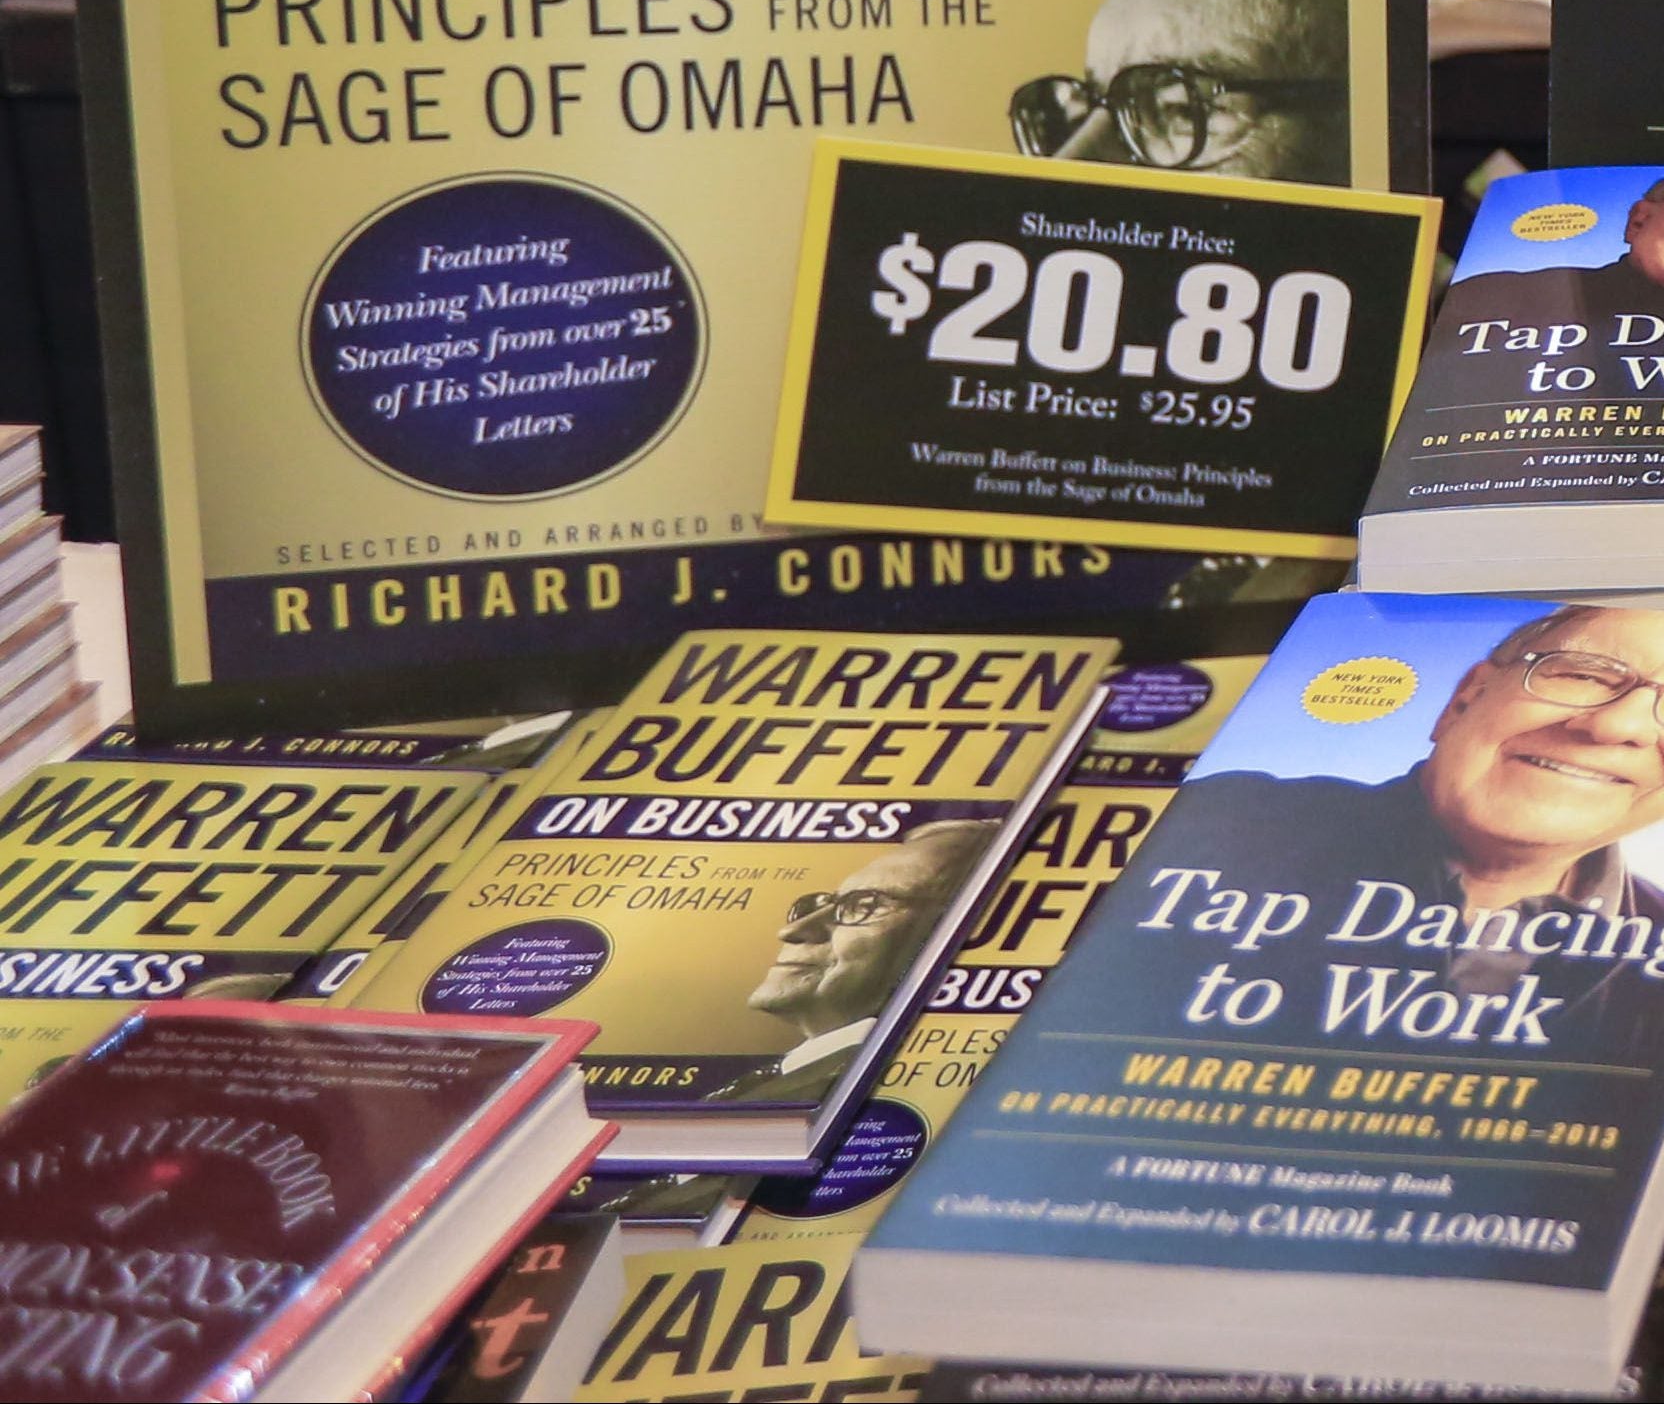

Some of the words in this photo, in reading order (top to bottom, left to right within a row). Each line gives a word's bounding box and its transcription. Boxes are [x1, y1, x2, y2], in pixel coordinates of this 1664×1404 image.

[219, 68, 452, 151] SAGE
[483, 63, 588, 139] OF
[620, 53, 916, 134] OMAHA
[418, 236, 570, 274] Featuring
[1021, 212, 1163, 247] Shareholder
[1169, 230, 1235, 254] Price:
[325, 293, 468, 329] Winning
[475, 265, 673, 311] Management
[871, 232, 1352, 392] $20.80
[337, 334, 479, 373] Strategies
[483, 325, 556, 363] from
[565, 318, 627, 345] over
[629, 306, 672, 337] 25
[1459, 319, 1588, 356] Tap
[374, 384, 406, 419] of
[413, 377, 469, 409] His
[478, 355, 657, 397] Shareholder
[1528, 361, 1596, 393] to
[473, 411, 575, 445] Letters
[948, 376, 1014, 412] List
[1026, 382, 1118, 418] Price:
[1140, 390, 1255, 430] $25.95
[1504, 406, 1642, 423] WARREN
[1422, 435, 1448, 447] ON
[1460, 428, 1604, 443] PRACTICALLY
[911, 443, 986, 467] Warren
[991, 449, 1057, 472] Buffett
[1062, 459, 1087, 473] on
[1092, 455, 1178, 480] Business:
[1183, 463, 1272, 487] Principles
[975, 475, 1022, 495] from
[1027, 478, 1057, 496] the
[1063, 481, 1106, 504] Sage
[1111, 484, 1131, 501] of
[1135, 486, 1205, 508] Omaha
[277, 535, 441, 565] SELECTED
[464, 529, 523, 551] AND
[545, 517, 710, 545] ARRANGED
[730, 514, 766, 534] BY
[274, 563, 622, 634] RICHARD
[670, 556, 727, 604] J.
[777, 538, 1112, 596] CONNORS
[658, 644, 1091, 711] WARREN
[580, 715, 1049, 787] BUFFETT
[537, 797, 628, 835] ON
[628, 800, 912, 839] BUSINESS
[84, 1117, 275, 1164] LITTLE
[252, 1132, 336, 1232] BOOK
